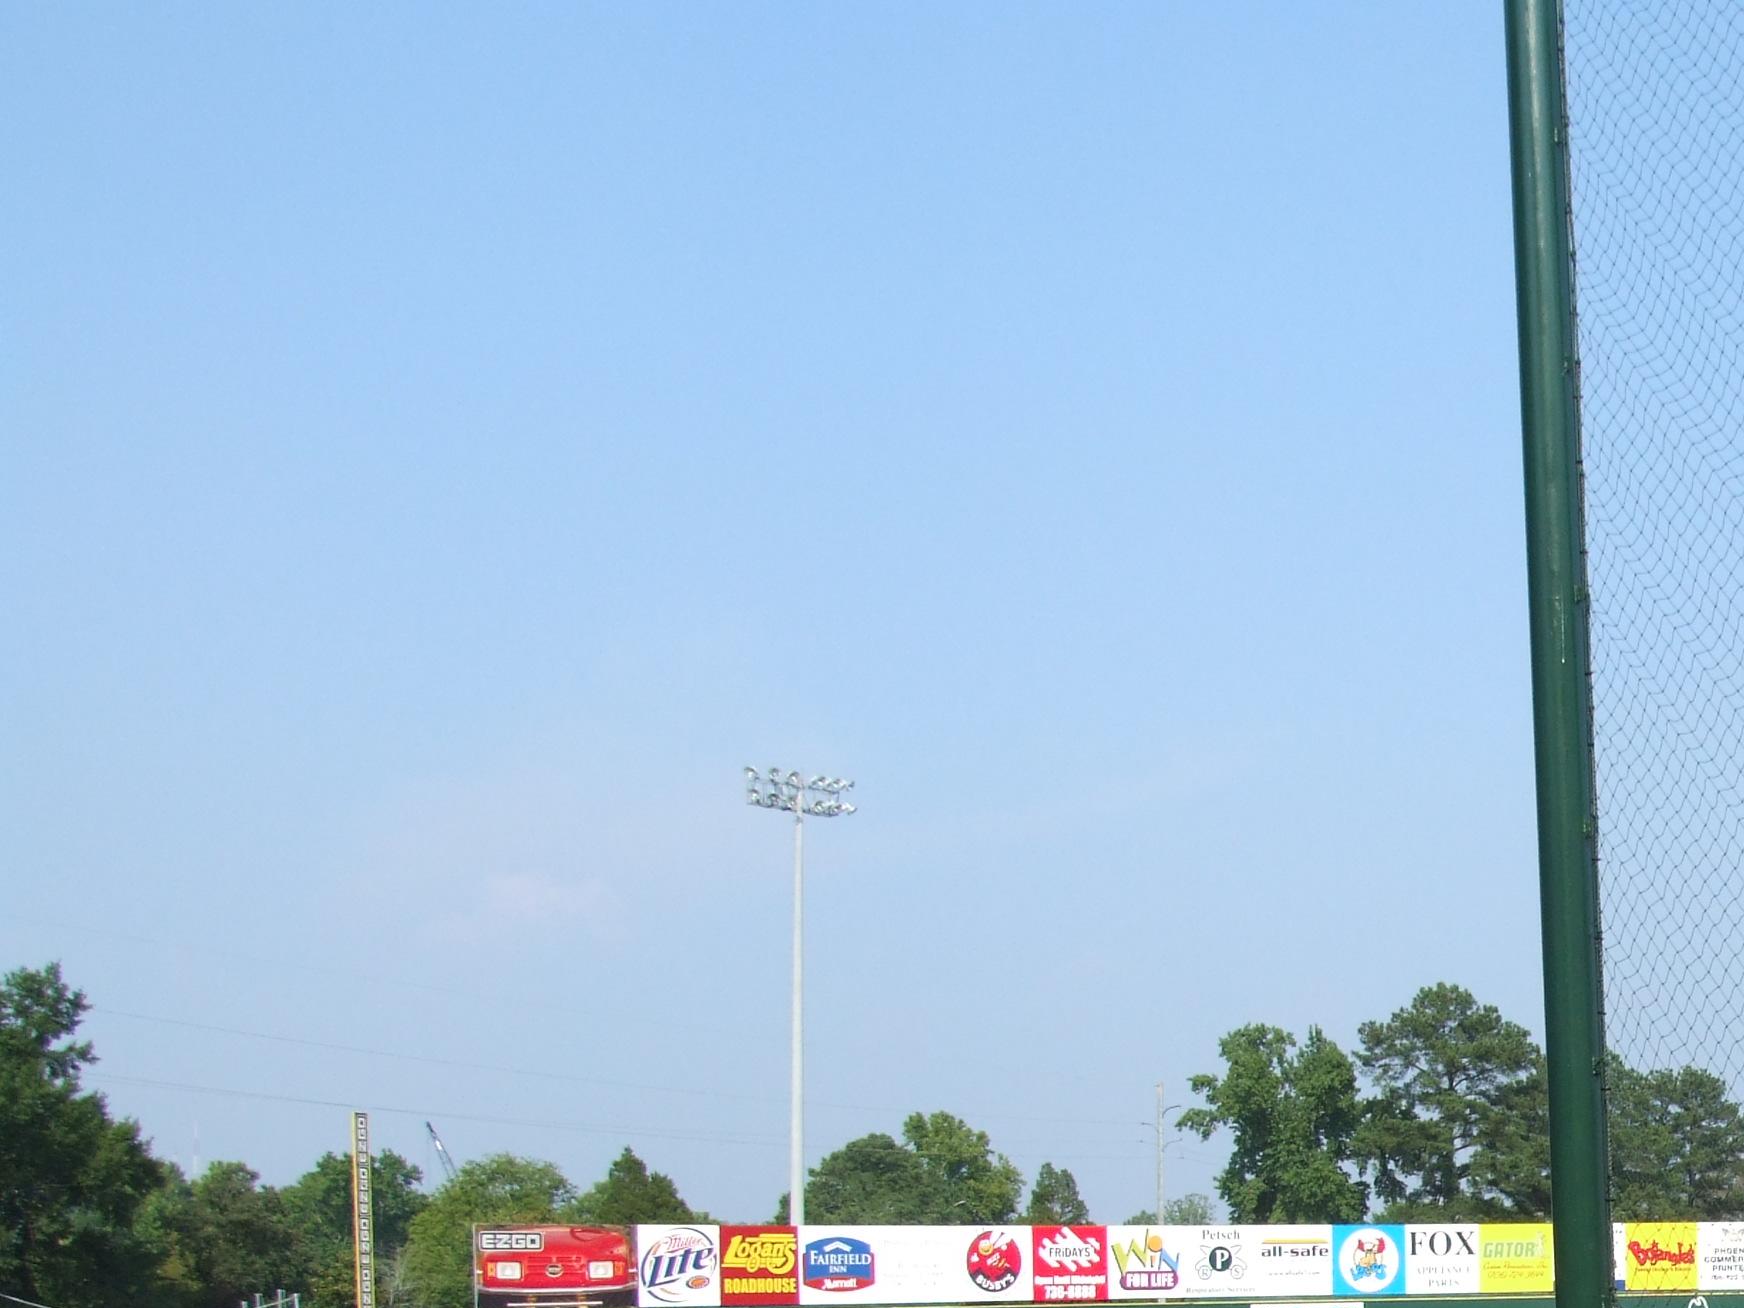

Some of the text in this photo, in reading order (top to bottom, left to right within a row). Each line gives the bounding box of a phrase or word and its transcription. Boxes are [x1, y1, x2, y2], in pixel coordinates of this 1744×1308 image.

[480, 1233, 540, 1250] EZGO
[1202, 1229, 1240, 1240] Petsch
[1261, 1245, 1329, 1257] all-safe
[1410, 1231, 1476, 1256] FOX
[809, 1251, 871, 1266] FAIRFIELD
[646, 1247, 714, 1289] Lite
[829, 1265, 847, 1274] INN
[724, 1277, 797, 1294] ROADHOUSE
[1126, 1273, 1174, 1287] FOR LIFE
